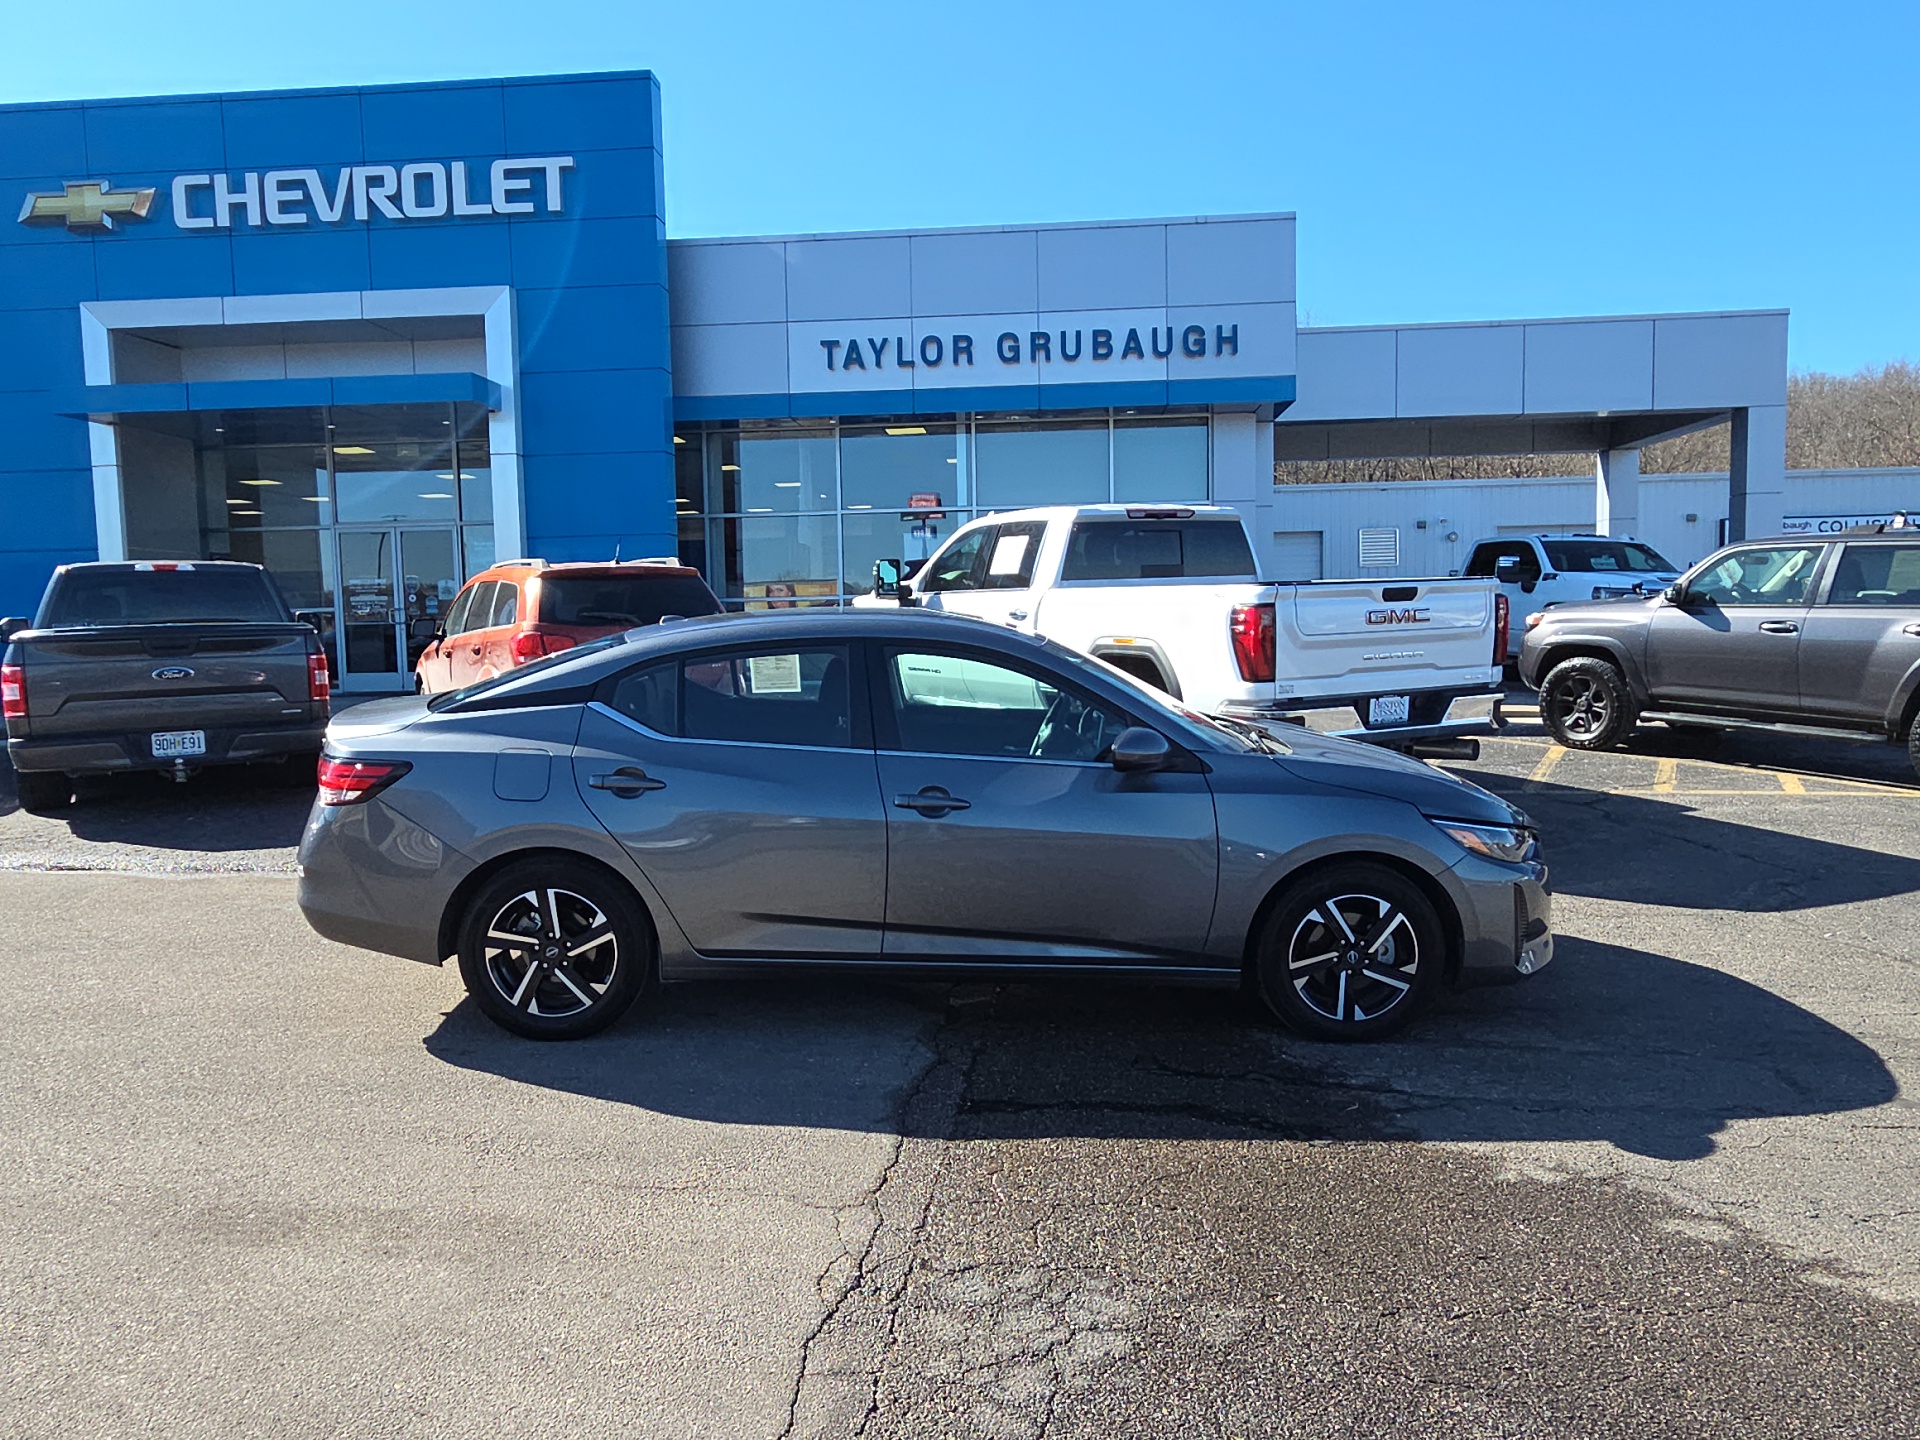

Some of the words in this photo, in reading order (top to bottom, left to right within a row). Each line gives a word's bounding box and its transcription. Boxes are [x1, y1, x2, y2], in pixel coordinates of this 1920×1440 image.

[171, 156, 574, 229] CHEVROLET
[820, 334, 974, 371] TAYLOR
[996, 324, 1240, 363] GRUBAUGH
[1365, 608, 1431, 625] GMC
[181, 736, 202, 750] E91
